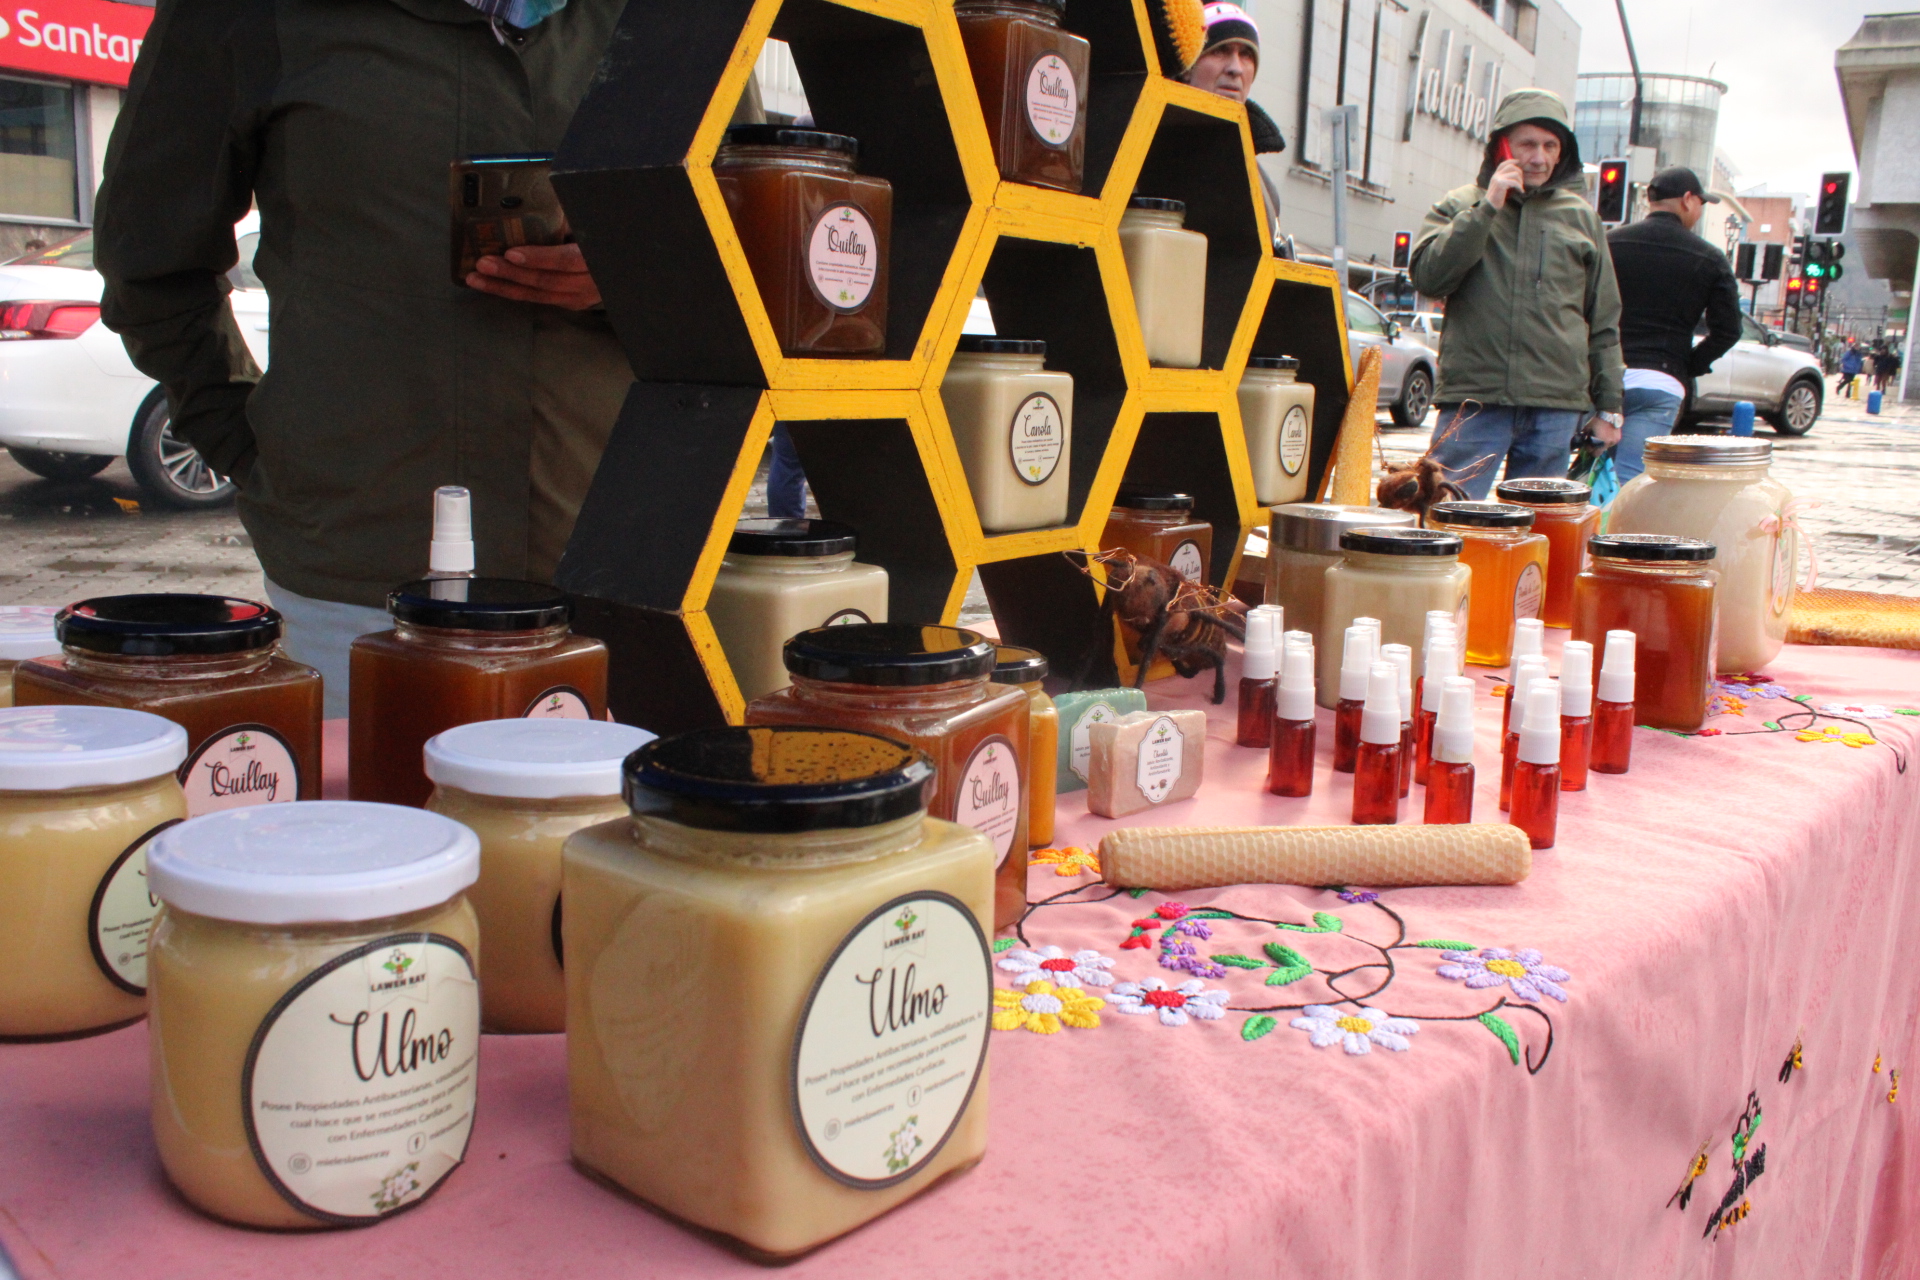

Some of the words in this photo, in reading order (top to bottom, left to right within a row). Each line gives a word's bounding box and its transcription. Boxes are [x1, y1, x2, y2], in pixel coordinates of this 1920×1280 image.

[1037, 69, 1069, 108] Quillay
[824, 223, 867, 266] Quillay
[1024, 414, 1052, 437] Canola
[204, 760, 279, 802] Quillay
[969, 771, 1010, 811] Quillay
[885, 935, 910, 949] LAWEN
[911, 930, 926, 941] RAY
[371, 978, 407, 992] LAWEN
[409, 973, 426, 985] RAY
[855, 963, 948, 1037] Ulmo
[329, 1008, 454, 1081] Ulmo
[805, 1073, 828, 1086] Posee
[830, 1056, 874, 1076] Propiedades
[862, 1072, 875, 1083] que
[877, 1068, 885, 1076] se
[261, 1101, 292, 1110] Posee
[295, 1098, 360, 1112] Propiedades
[290, 1119, 312, 1128] cual
[315, 1118, 339, 1127] hace
[343, 1115, 362, 1126] que
[365, 1112, 376, 1121] se
[379, 1097, 429, 1117] recomiende
[851, 1092, 865, 1103] con
[328, 1134, 347, 1143] con
[350, 1118, 417, 1140] Enfermedades
